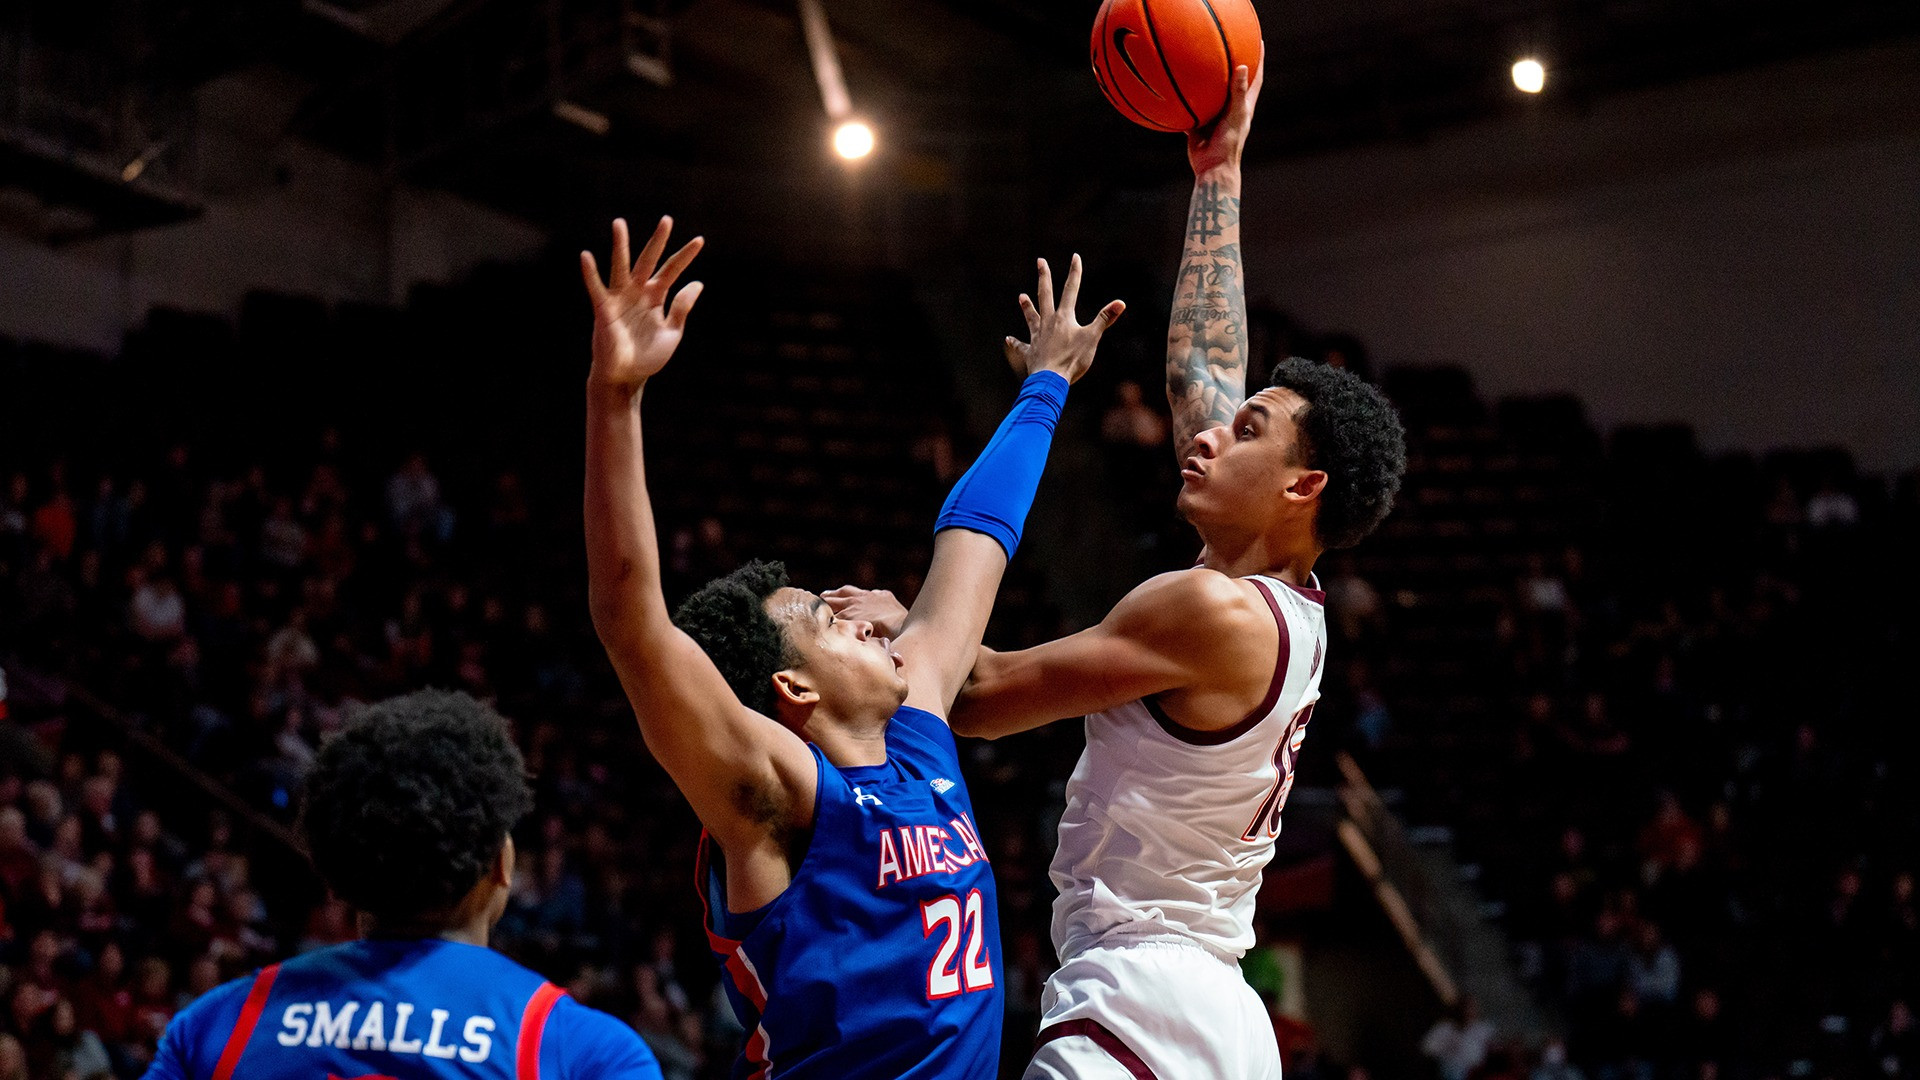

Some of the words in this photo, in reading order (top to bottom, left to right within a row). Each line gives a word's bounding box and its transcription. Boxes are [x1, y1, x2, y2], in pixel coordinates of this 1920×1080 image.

[876, 811, 990, 890] AMECAN
[919, 888, 994, 1000] 22
[277, 1001, 496, 1063] SMALLS
